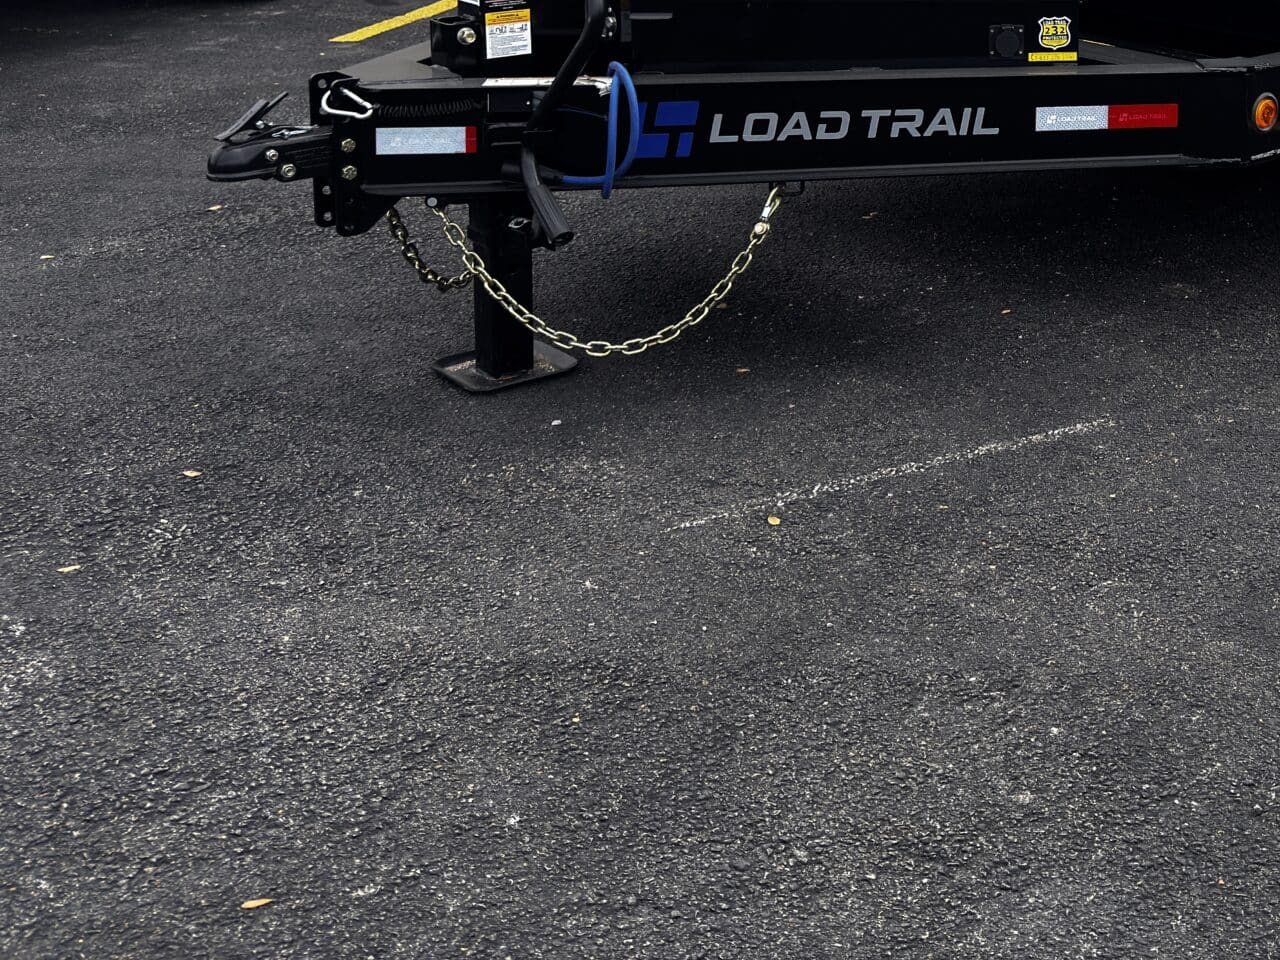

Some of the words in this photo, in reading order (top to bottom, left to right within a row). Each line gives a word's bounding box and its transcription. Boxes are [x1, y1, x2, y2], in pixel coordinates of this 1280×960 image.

[1045, 26, 1065, 35] 232
[709, 111, 850, 143] LOAD
[861, 107, 999, 139] TRAIL
